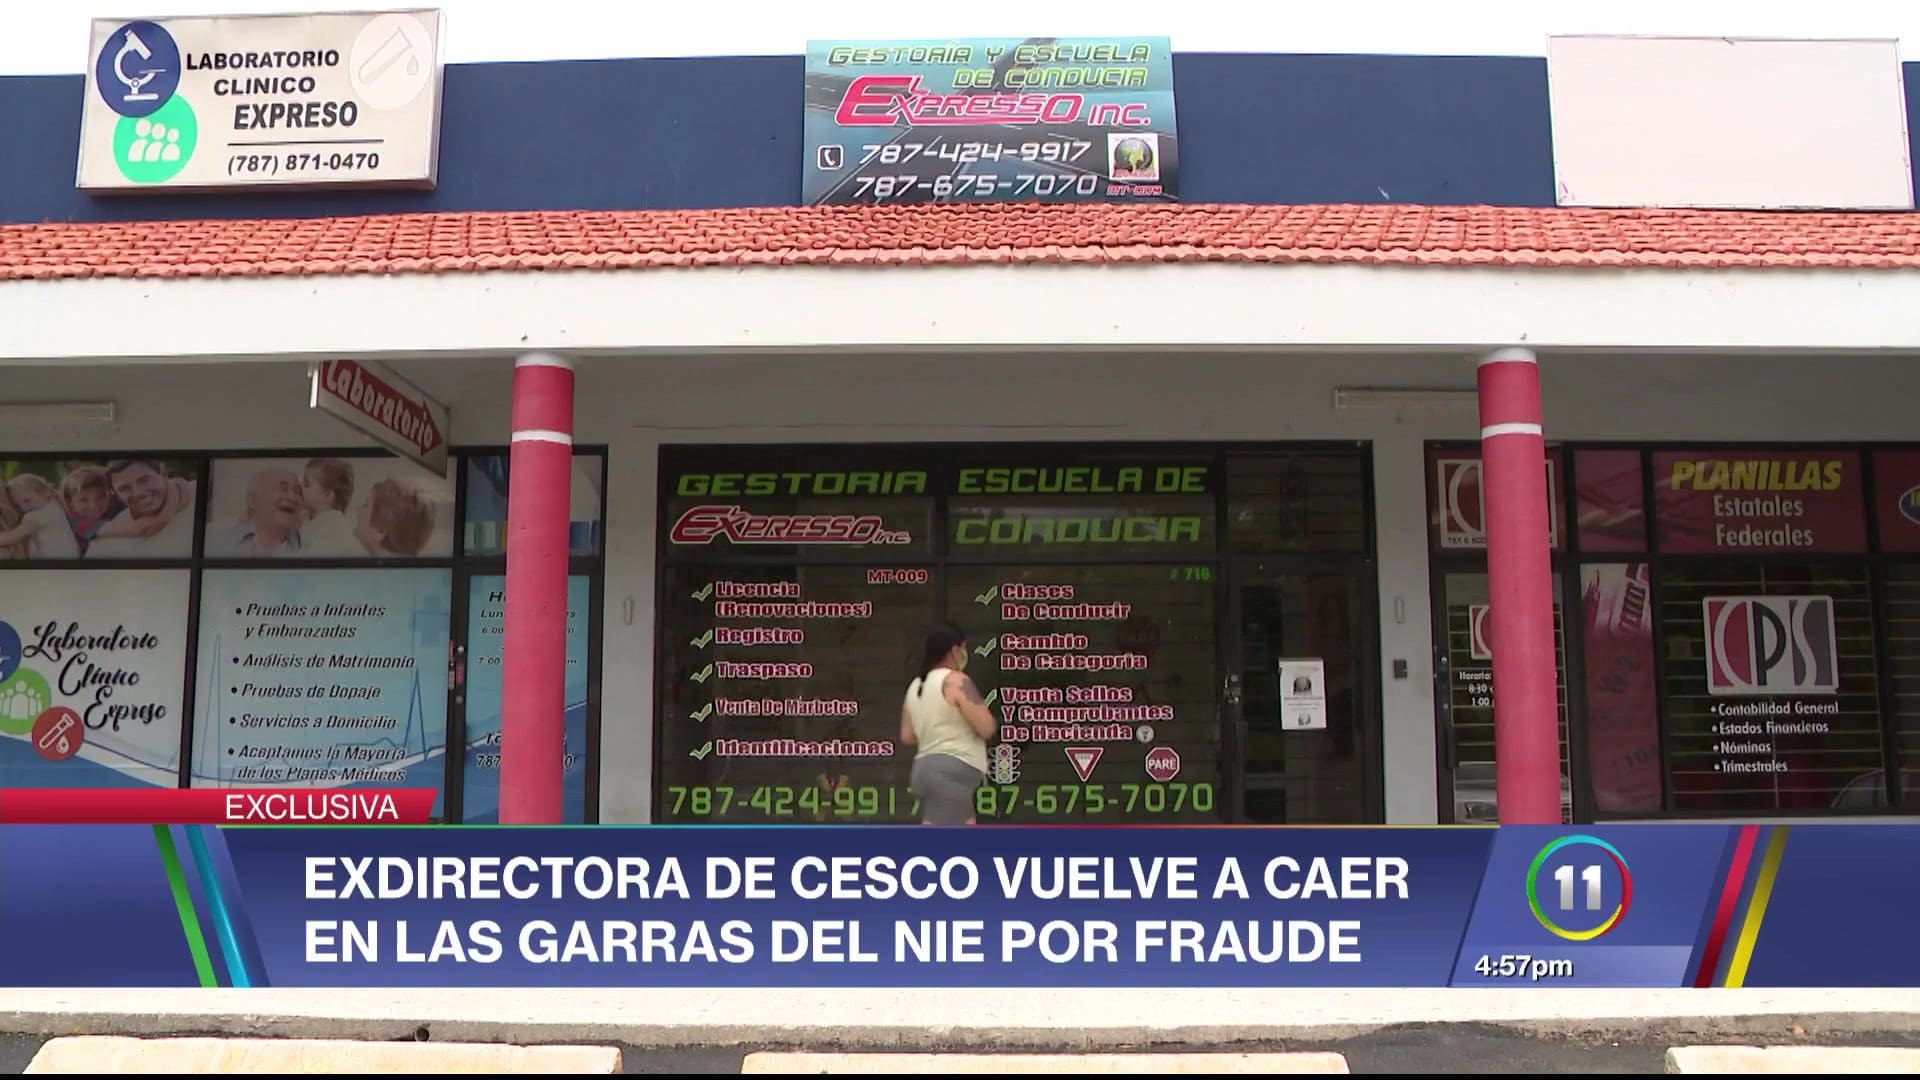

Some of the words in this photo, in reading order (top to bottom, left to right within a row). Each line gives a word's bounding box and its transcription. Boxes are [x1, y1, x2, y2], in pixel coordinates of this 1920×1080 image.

[186, 50, 339, 70] LABORATORIO
[984, 46, 1003, 63] Y
[1014, 44, 1150, 63] ESCUELA
[213, 77, 316, 96] CLINICO
[952, 69, 993, 88] DE
[233, 101, 358, 130] EXPRESO
[859, 142, 1092, 164] 787-424-9917
[228, 155, 278, 175] (787)
[285, 153, 379, 171] 871-0470
[853, 175, 1098, 198] 787-675-7070
[326, 359, 433, 450] Laboratorio
[676, 471, 927, 497] GESTORIA
[957, 467, 1144, 494] ESCUELA
[1154, 467, 1208, 493] DE
[1671, 460, 1842, 491] PLANILLAS
[1713, 495, 1804, 517] Estatales
[1716, 523, 1814, 547] Federales
[867, 569, 929, 584] MT-009
[715, 581, 800, 598] Licencia
[1001, 583, 1074, 600] Clases
[246, 603, 307, 616] Pruebas
[310, 606, 319, 616] a
[324, 603, 386, 616] Infantes
[715, 601, 872, 617] (Renovaciones)
[1001, 603, 1030, 620] De
[1033, 602, 1131, 620] Conducir
[245, 627, 253, 638] y
[258, 624, 357, 638] Embarazadas
[715, 627, 804, 645] Registro
[22, 621, 159, 663] Laboratorio
[1000, 633, 1089, 650] Cambio
[243, 654, 301, 667] Análisis
[307, 654, 325, 667] de
[328, 654, 415, 668] Matrimonio
[1001, 653, 1032, 670] De
[715, 662, 813, 679] Traspaso
[241, 684, 302, 698] Pruebas
[307, 684, 325, 698] de
[329, 684, 381, 700] Dopaje
[1001, 687, 1063, 704] Venta
[1066, 686, 1132, 702] Sellos
[84, 685, 167, 732] Expreso
[715, 699, 760, 715] Venta
[762, 699, 782, 715] De
[784, 699, 858, 716] Marbetes
[1001, 705, 1014, 722] Y
[1018, 704, 1174, 723] Comprobantes
[1718, 702, 1791, 716] Contabilidad
[1794, 701, 1839, 715] General
[240, 714, 309, 728] Servicios
[313, 717, 322, 728] a
[326, 715, 396, 729] Domicilio
[1719, 721, 1762, 735] Estados
[1766, 721, 1829, 734] Financieros
[1001, 726, 1029, 742] De
[1032, 724, 1132, 742] Hacienda
[238, 745, 322, 759] Aceptamos
[326, 745, 341, 760] la
[715, 739, 895, 757] Identificaciones
[1720, 741, 1772, 755] Nóminas
[238, 766, 256, 778] de
[259, 765, 283, 778] los
[287, 766, 338, 781] Planes
[1721, 760, 1788, 773] Trimestrales
[976, 783, 1214, 815] 87-675-7070
